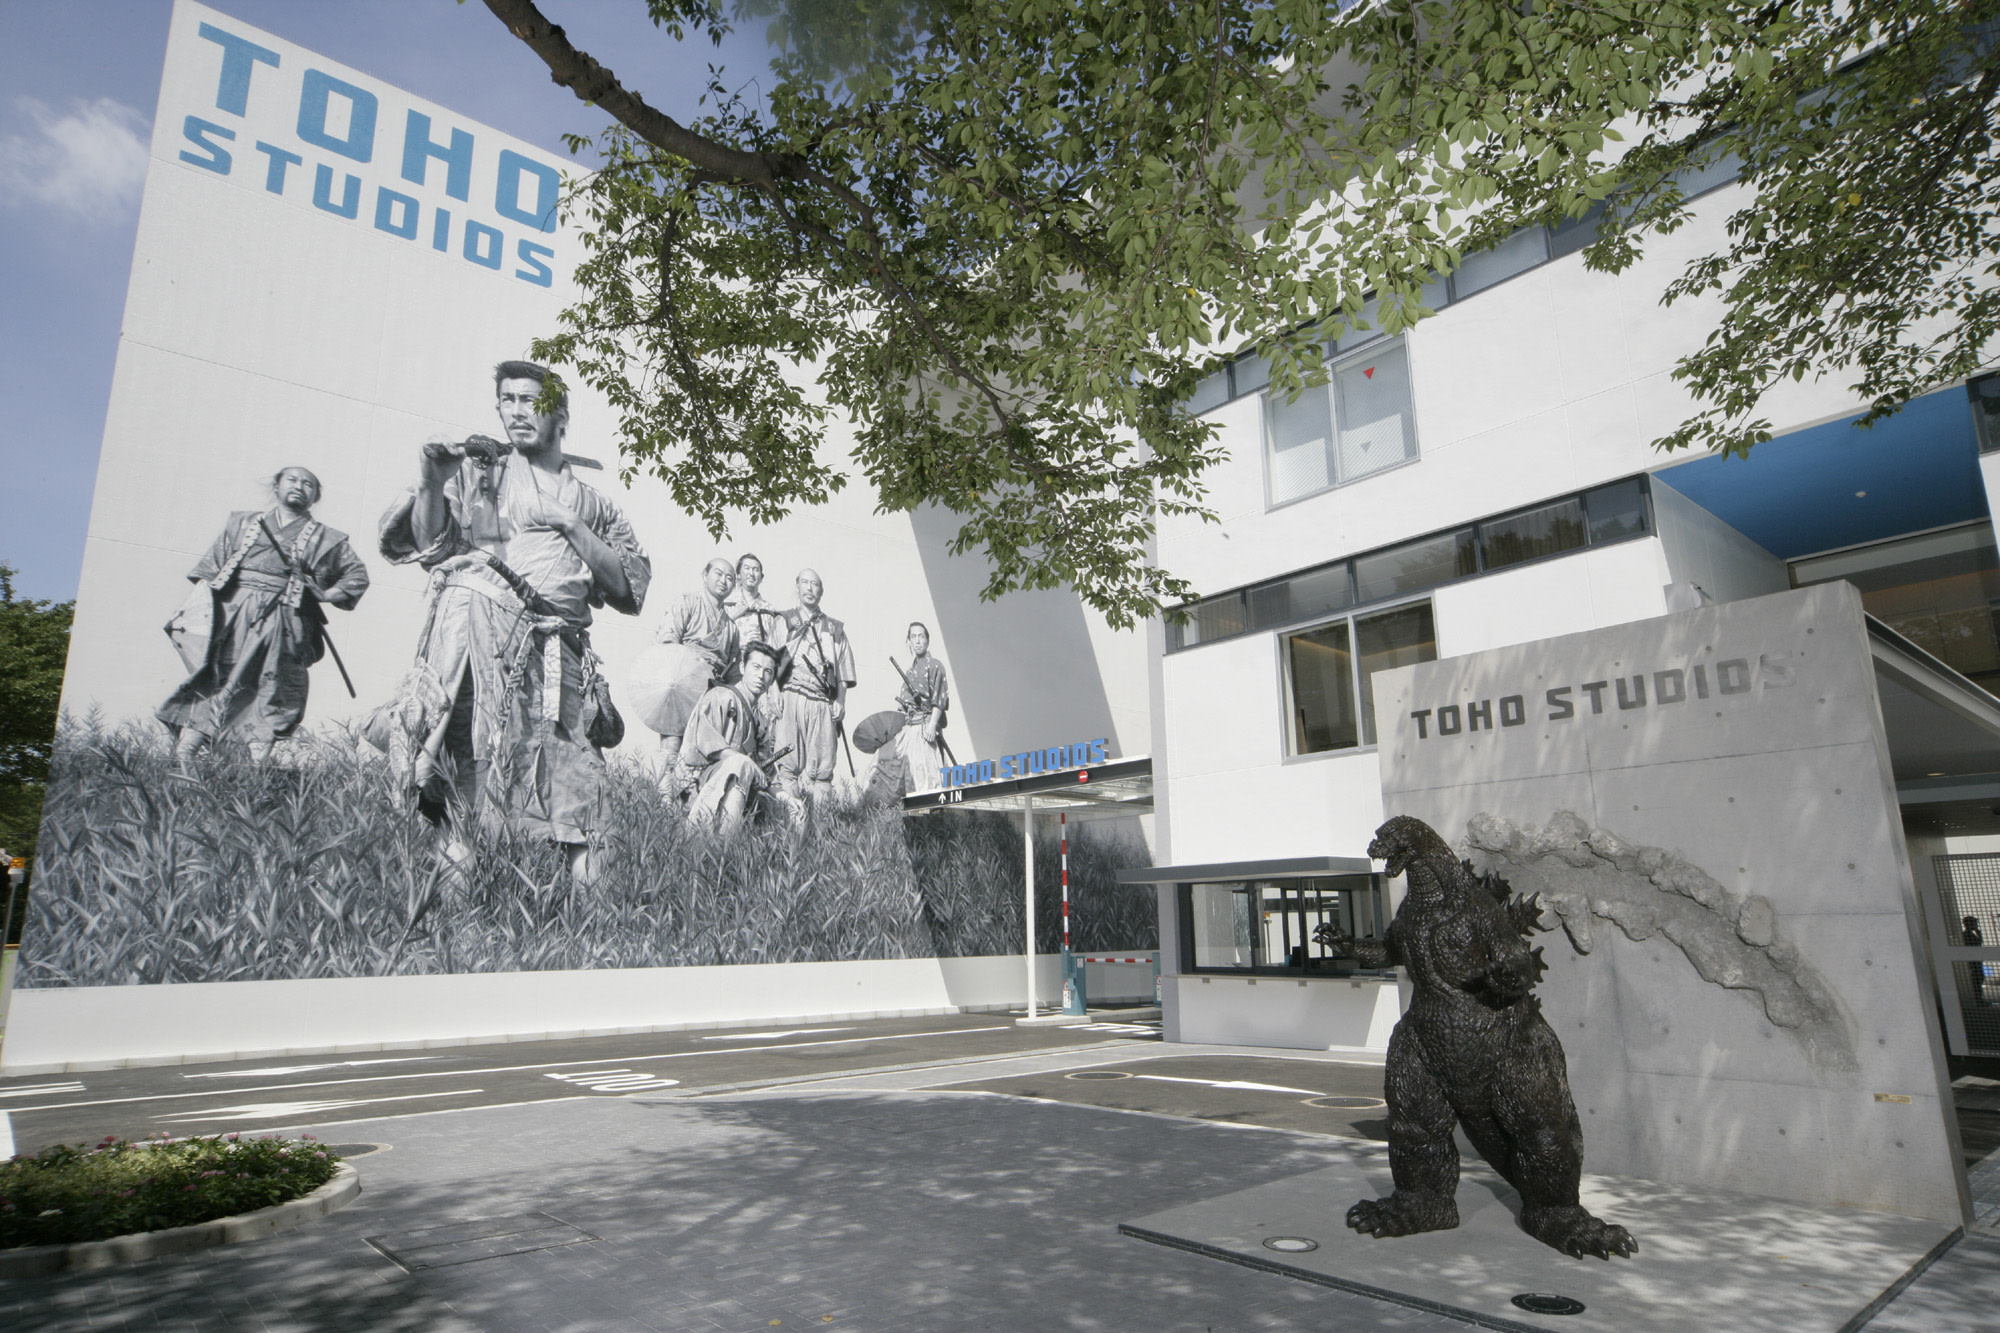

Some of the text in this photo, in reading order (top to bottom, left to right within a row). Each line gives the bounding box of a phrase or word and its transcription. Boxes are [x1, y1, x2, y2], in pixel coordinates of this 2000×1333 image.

[198, 20, 561, 235] TOHO
[178, 114, 555, 289] STUDIOS
[1410, 649, 1799, 740] TOHO STUDIOS
[939, 738, 1109, 789] TOHO STUDIOS
[950, 790, 963, 803] IN
[543, 1068, 681, 1092] OUT
